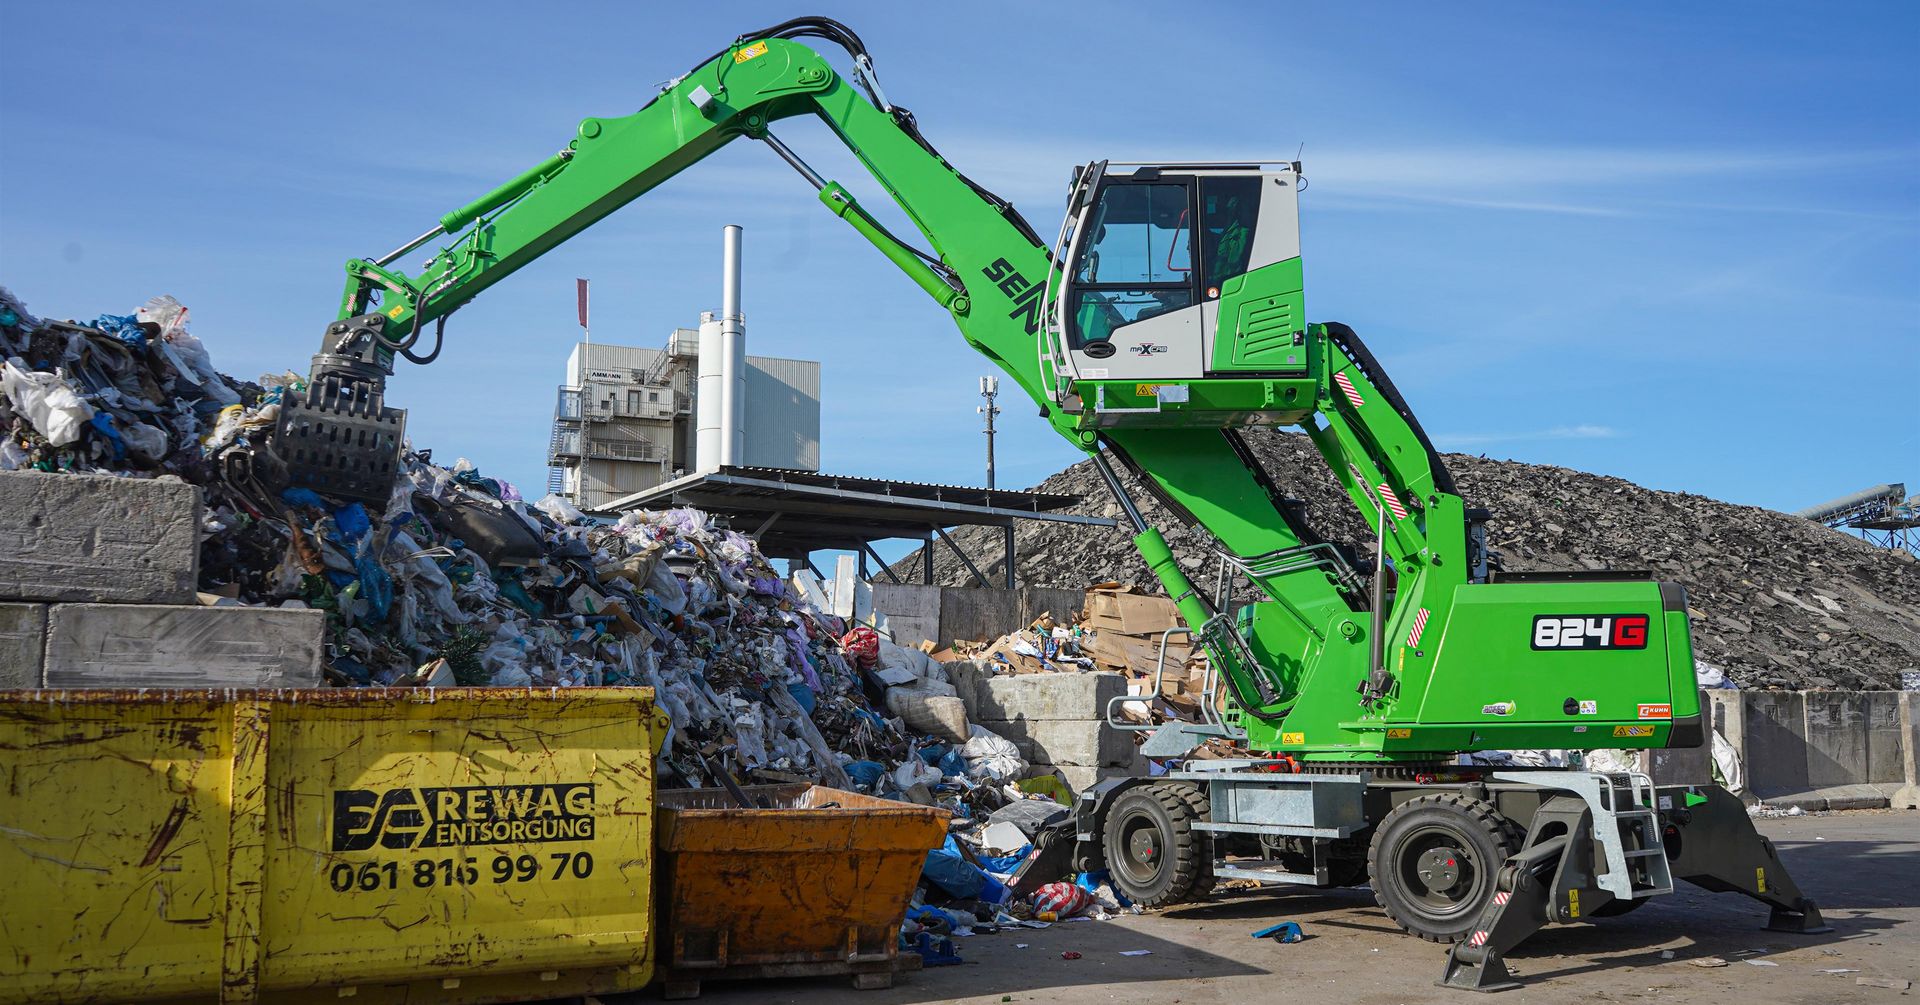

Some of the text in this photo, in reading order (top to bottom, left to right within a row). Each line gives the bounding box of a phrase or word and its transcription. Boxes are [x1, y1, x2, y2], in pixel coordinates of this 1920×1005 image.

[592, 371, 621, 379] AMMANN
[1535, 618, 1646, 647] 824G
[436, 785, 594, 821] REWAG
[436, 816, 592, 844] ENTSORGUNG
[330, 852, 594, 893] 061 816 99 70
